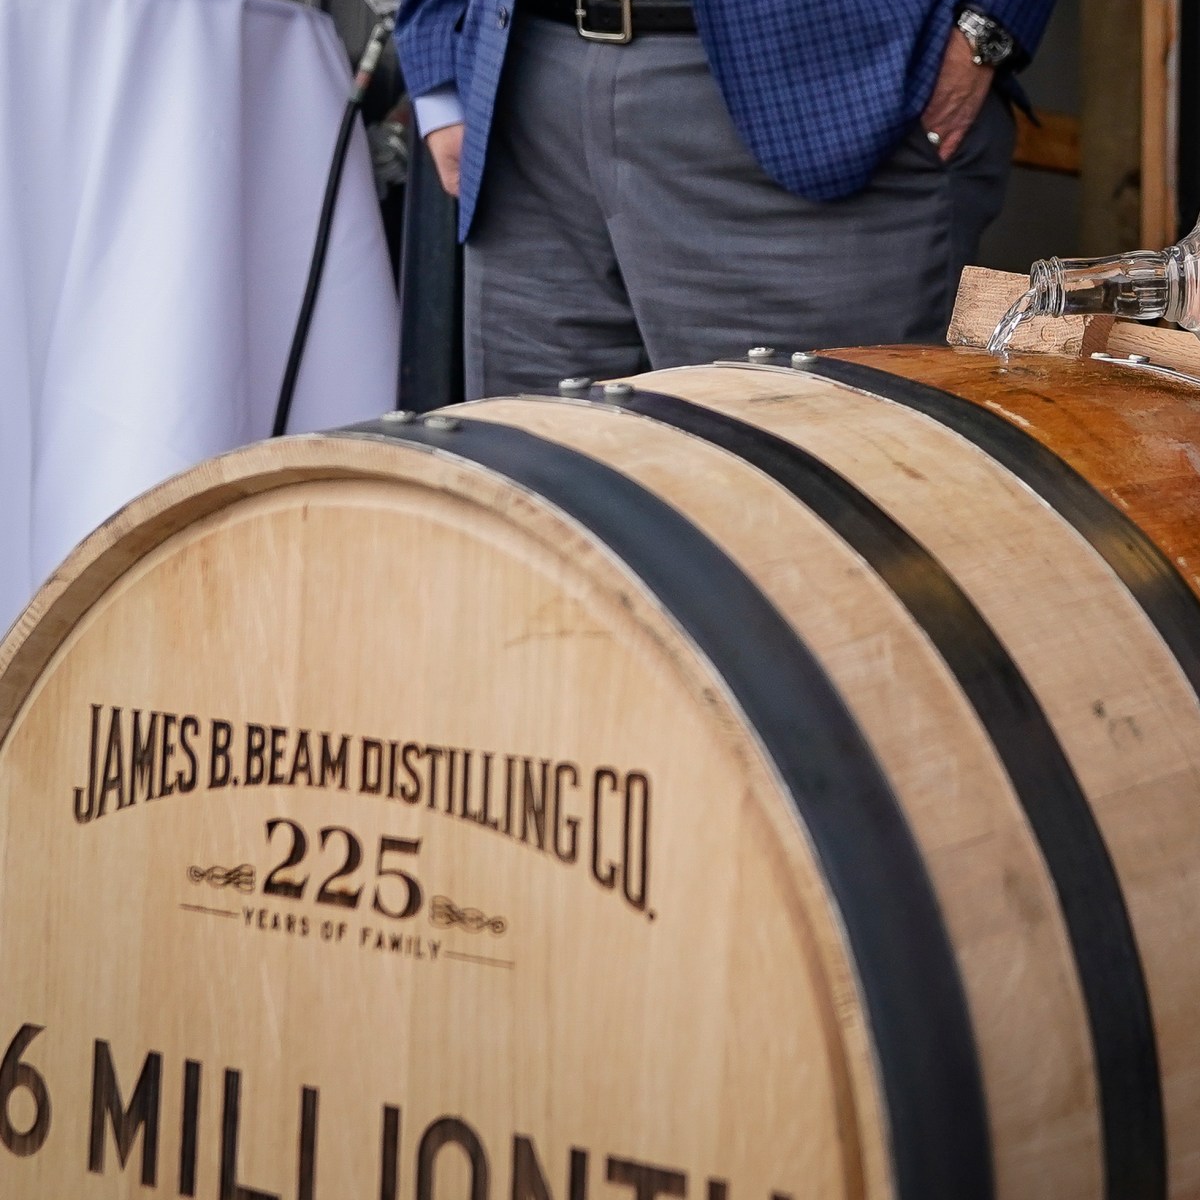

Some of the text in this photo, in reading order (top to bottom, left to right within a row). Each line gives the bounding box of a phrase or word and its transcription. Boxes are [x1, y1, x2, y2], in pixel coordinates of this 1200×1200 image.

[73, 703, 202, 824] JAMES
[244, 721, 352, 792] BEAM
[359, 736, 583, 866] DISTILLING
[589, 765, 657, 922] CO.
[262, 817, 425, 919] 225
[241, 906, 443, 963] YEARS OF FAMILY
[0, 1023, 793, 1200] 6 MILLION
